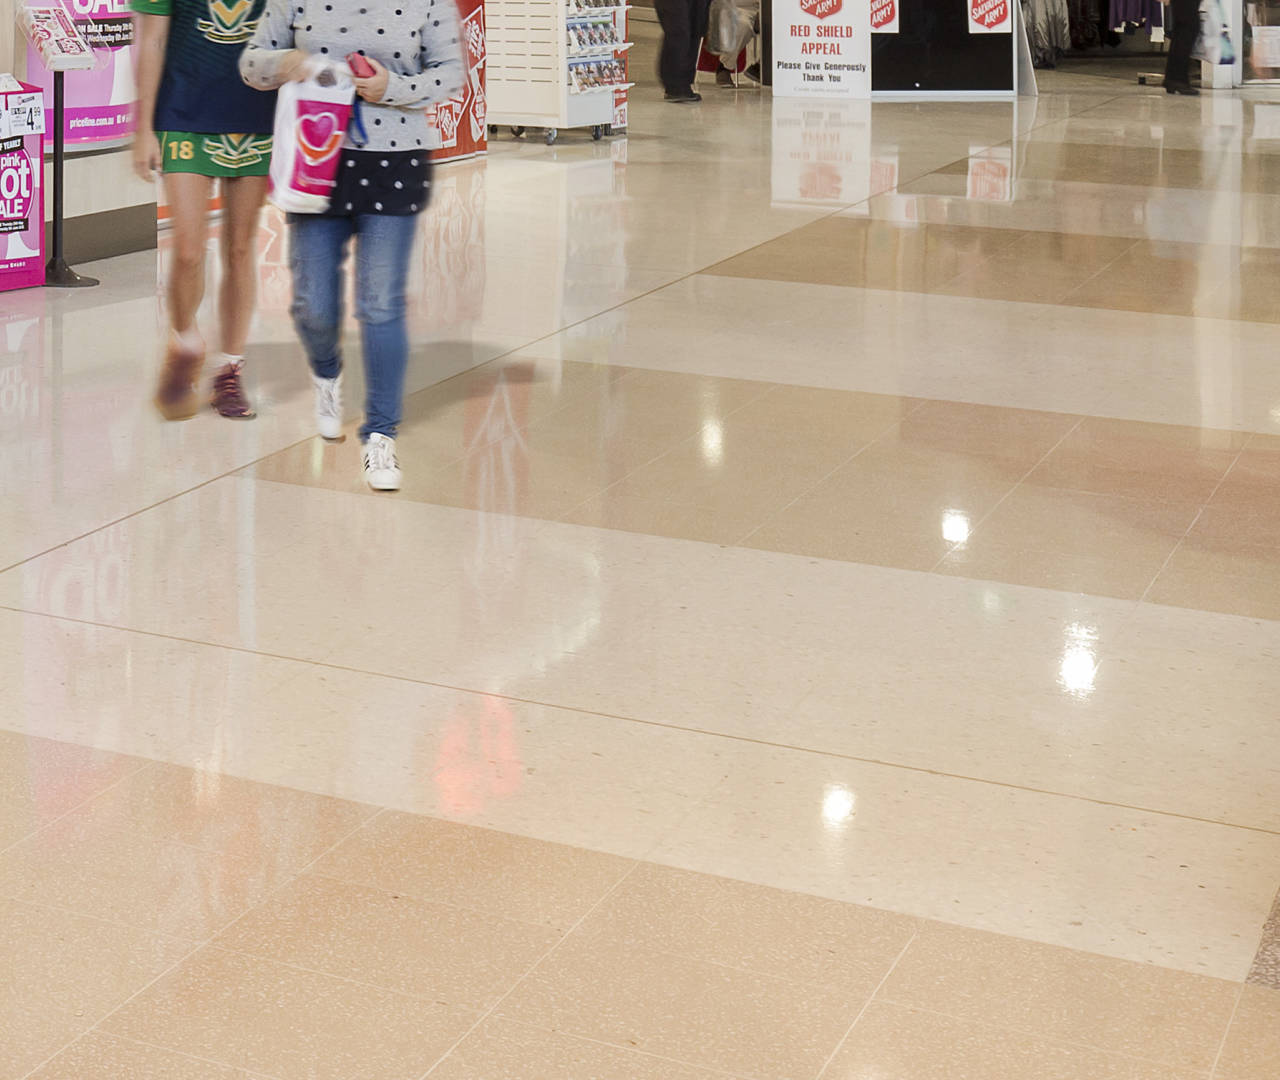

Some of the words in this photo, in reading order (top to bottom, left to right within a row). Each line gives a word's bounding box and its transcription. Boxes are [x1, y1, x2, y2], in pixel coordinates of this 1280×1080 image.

[872, 4, 892, 26] ARMY
[985, 3, 1005, 25] ARMY
[790, 24, 811, 37] RED
[816, 24, 853, 38] SHIELD
[801, 42, 842, 55] APPEAL
[777, 61, 801, 70] Please
[805, 62, 821, 70] Give
[824, 62, 867, 72] Generously
[802, 73, 824, 82] Thank
[828, 73, 841, 82] You
[169, 140, 195, 160] 18
[0, 153, 21, 171] pink
